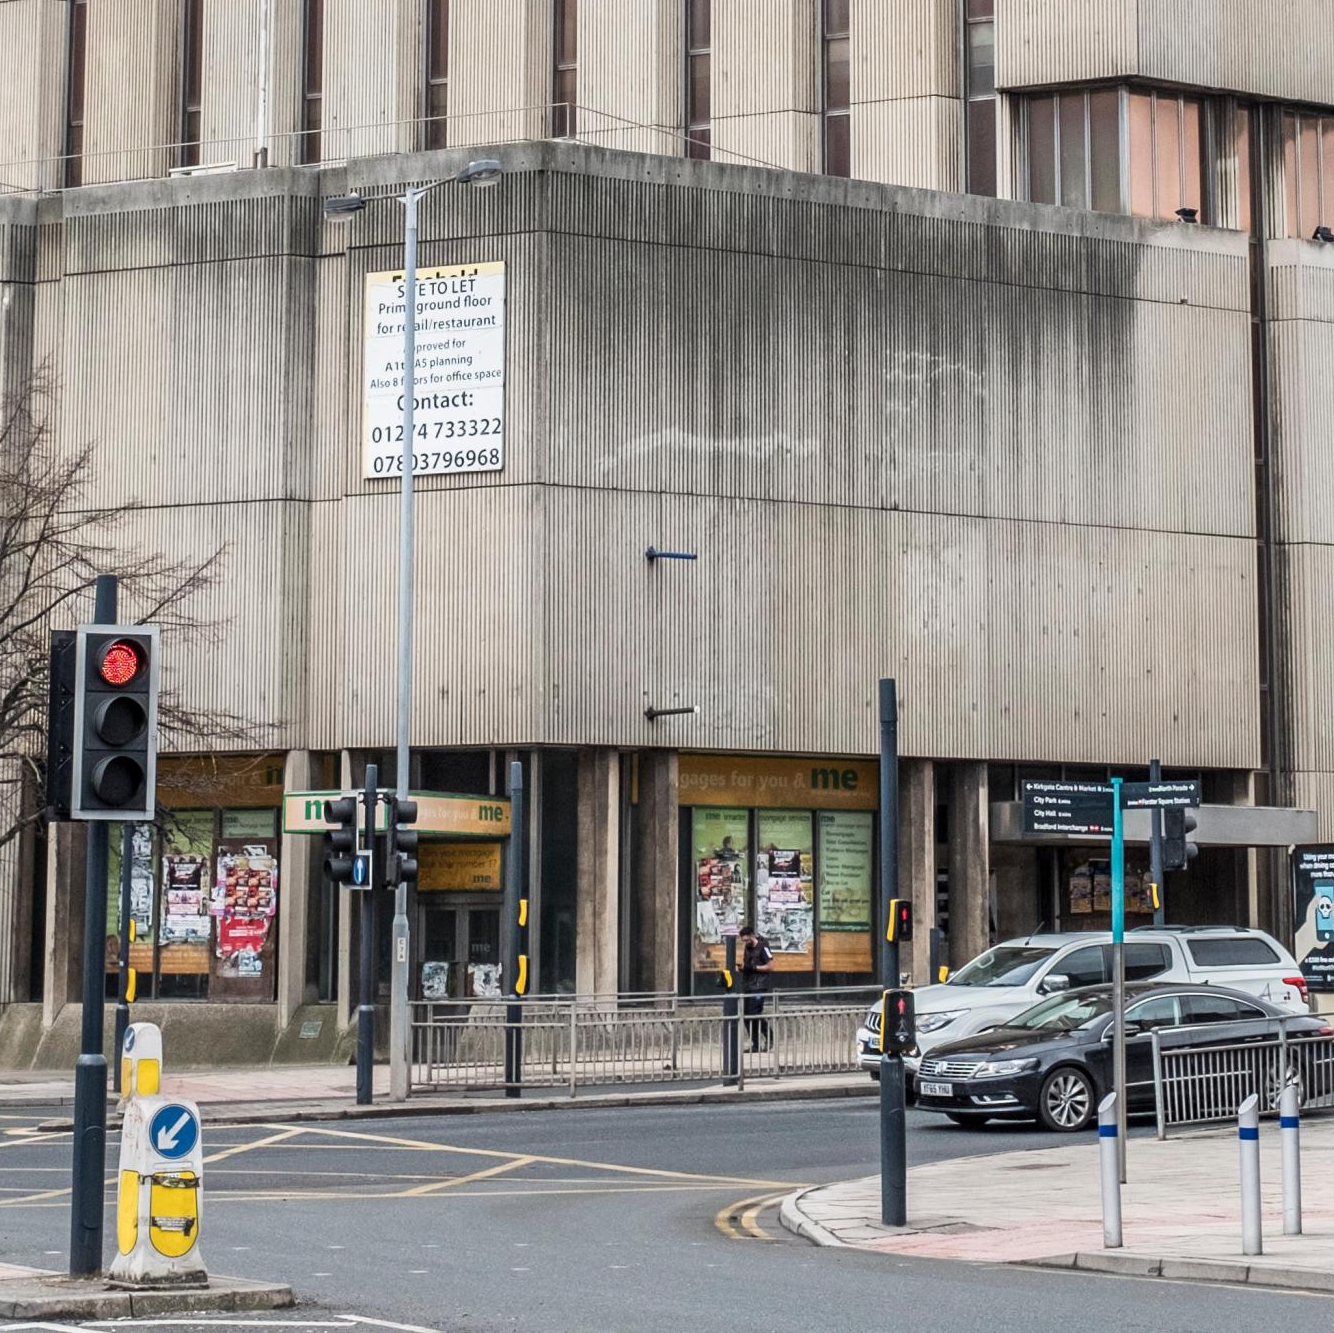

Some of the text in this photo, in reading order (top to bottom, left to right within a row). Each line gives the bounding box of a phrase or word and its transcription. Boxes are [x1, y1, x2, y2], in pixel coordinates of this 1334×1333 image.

[398, 278, 476, 298] SE TO LET
[378, 295, 492, 315] Prim ground floor
[377, 315, 496, 335] for reail/restaurant
[452, 339, 466, 349] for
[429, 355, 473, 367] planning
[370, 379, 391, 389] Also
[392, 377, 399, 386] 8
[430, 374, 444, 383] for
[447, 369, 472, 382] office
[475, 369, 502, 381] space
[433, 418, 501, 439] 733322
[730, 770, 754, 787] for
[759, 775, 788, 792] you
[793, 774, 805, 788] &
[811, 767, 859, 790] me
[1033, 796, 1044, 805] City
[1045, 796, 1057, 804] Park
[478, 804, 503, 822] me
[1034, 809, 1044, 817] City
[1045, 809, 1057, 817] Hall
